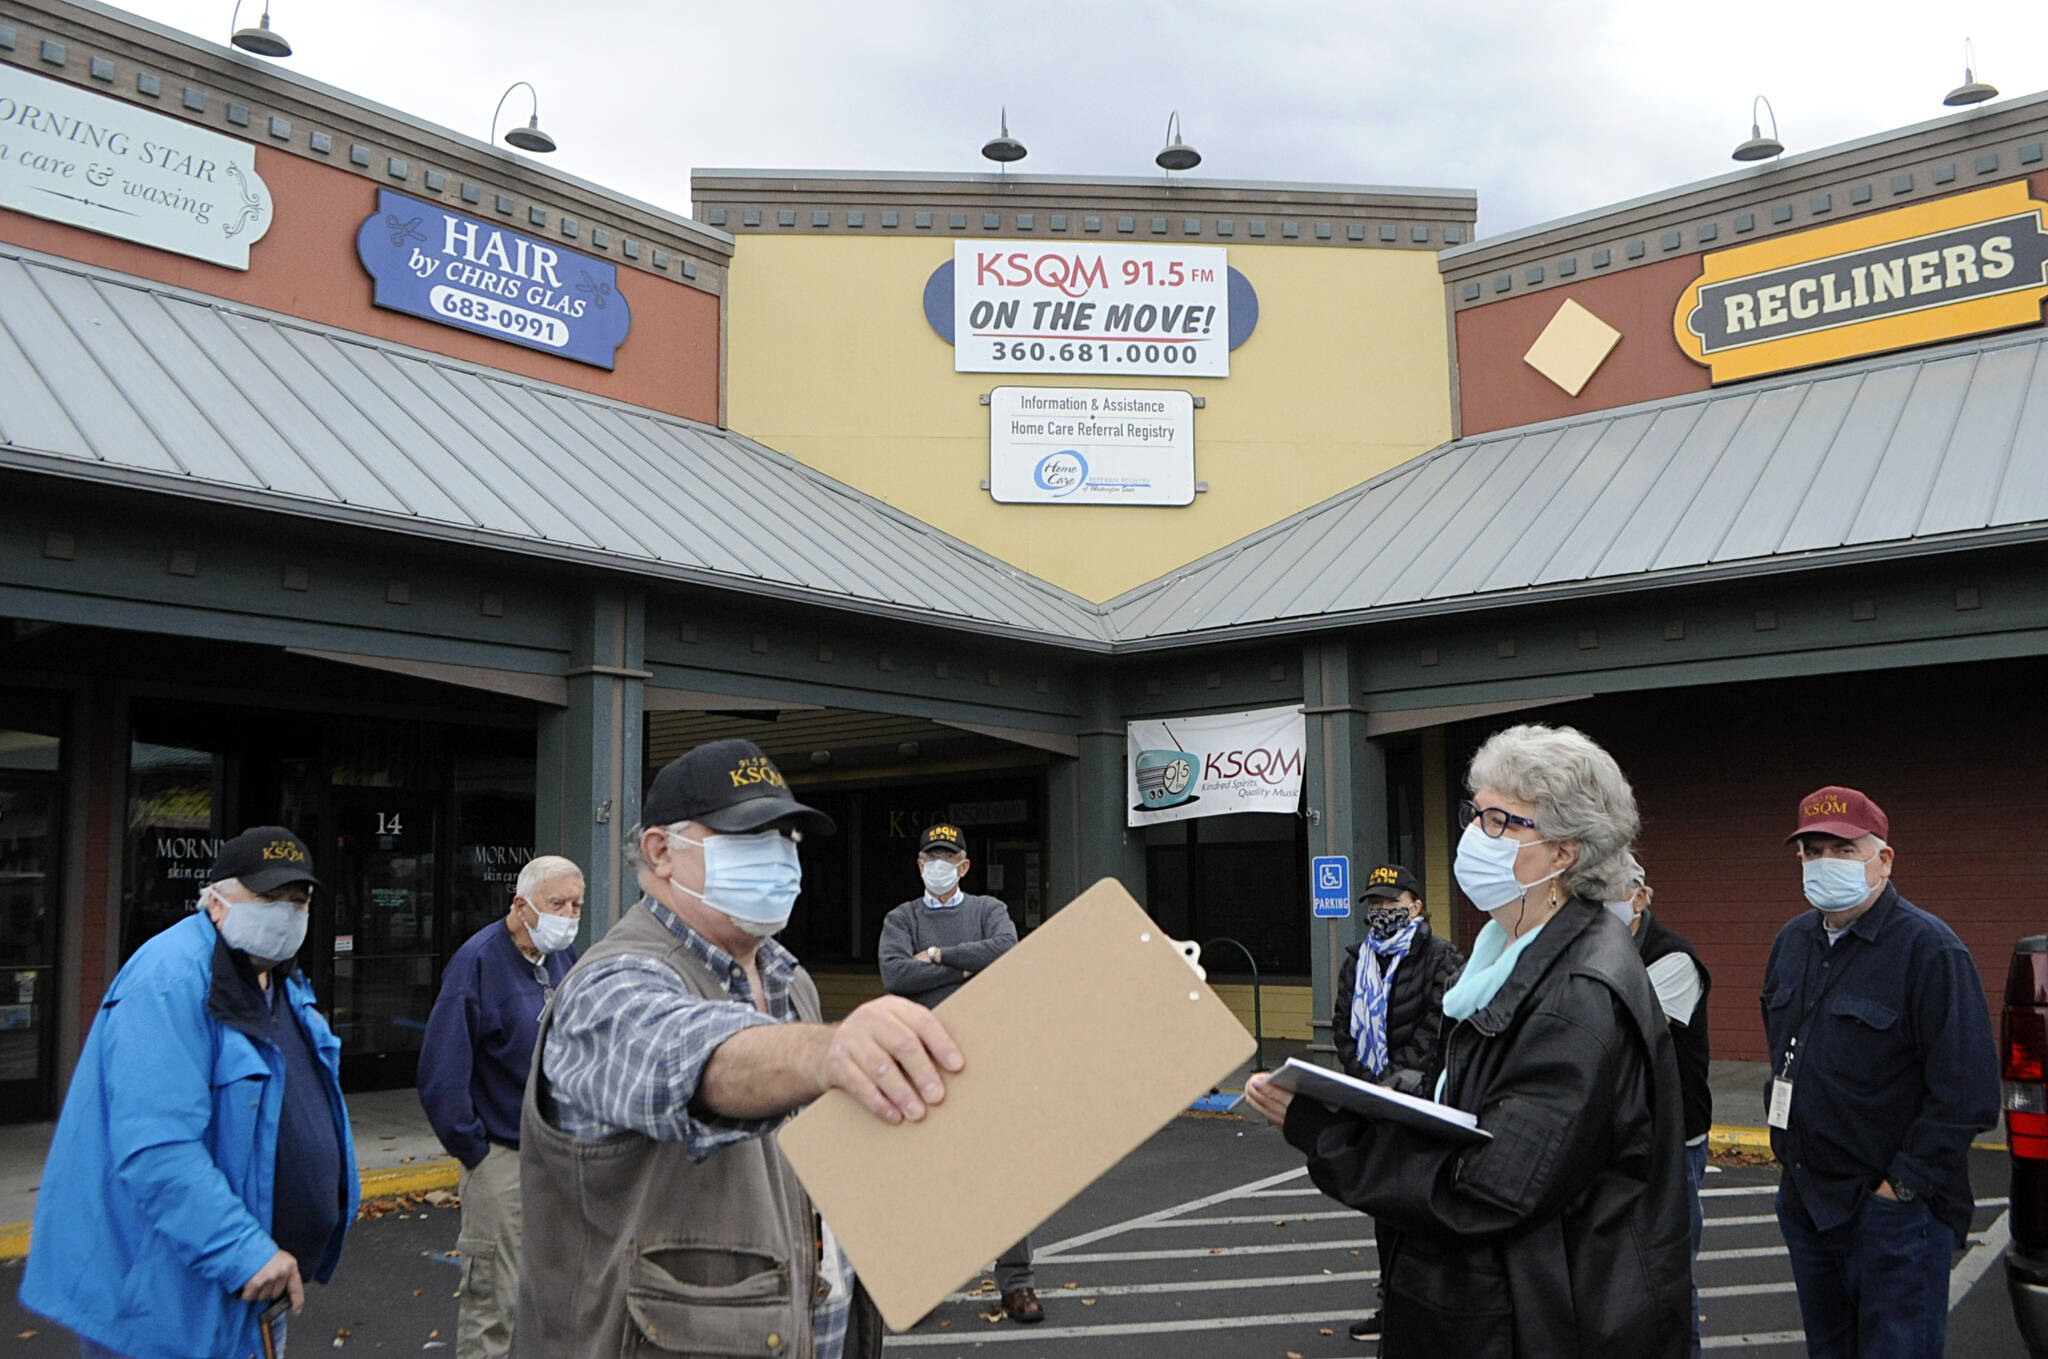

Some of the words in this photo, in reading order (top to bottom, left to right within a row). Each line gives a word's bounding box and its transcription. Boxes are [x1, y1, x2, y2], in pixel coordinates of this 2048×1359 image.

[0, 98, 130, 156] ORNING
[138, 141, 216, 183] STAR
[20, 150, 76, 178] care
[86, 162, 114, 187] &
[122, 179, 214, 225] waxing
[442, 215, 562, 288] HAIR
[408, 248, 440, 278] by
[446, 261, 521, 298] CHRIS
[526, 286, 587, 318] GLAS
[977, 253, 1109, 298] KSQM
[1122, 260, 1184, 286] 91.5
[1191, 269, 1214, 282] FM
[1723, 236, 2016, 334] RECLINERS
[443, 293, 555, 340] 683-0991
[970, 300, 1020, 330] ON
[1033, 301, 1096, 331] THE
[1104, 303, 1216, 334] MOVE!
[992, 341, 1197, 364] 360.681.0000
[1021, 395, 1087, 410] Information
[1091, 398, 1099, 411] &
[1103, 397, 1164, 413] Assistance
[1011, 420, 1044, 435] Home
[1048, 421, 1074, 436] Care
[1078, 422, 1123, 437] Referral
[1128, 424, 1175, 442] Registry
[1044, 460, 1077, 473] Home
[1047, 473, 1075, 486] Care
[1204, 748, 1302, 785] KSQM
[1202, 781, 1230, 792] Kindred
[1238, 787, 1270, 799] Quality
[1273, 787, 1299, 797] Music
[1804, 801, 1848, 817] KSQM
[376, 812, 403, 835] 14
[929, 826, 958, 838] KSQM
[168, 862, 193, 879] skin
[193, 868, 213, 879] car
[483, 867, 502, 882] skin
[502, 872, 518, 882] car
[1315, 897, 1350, 910] PARKING
